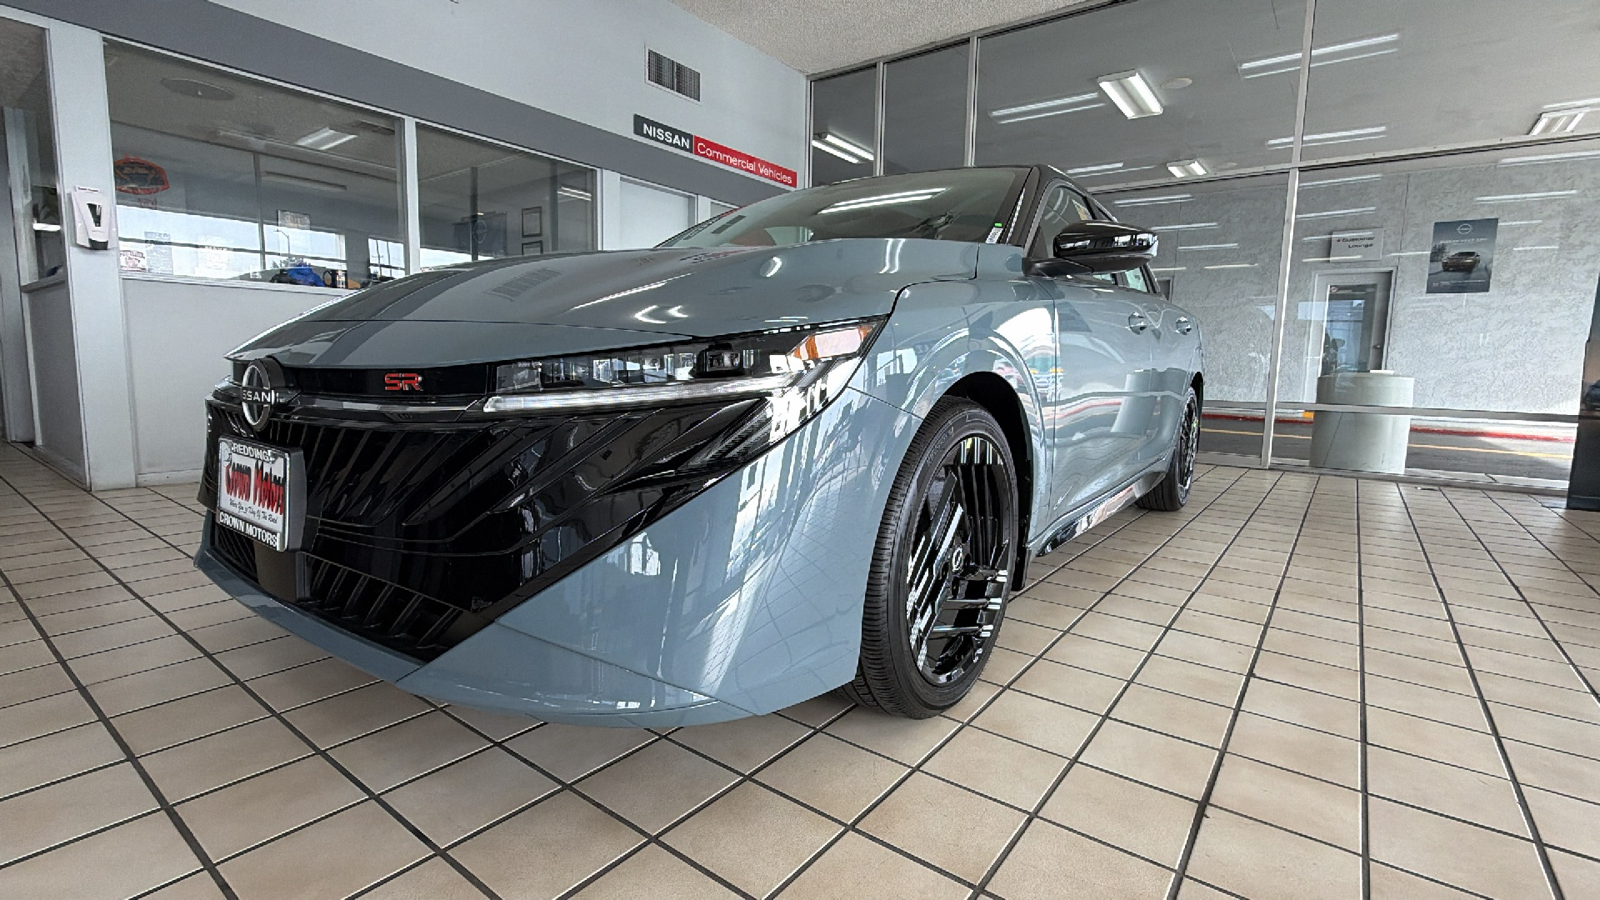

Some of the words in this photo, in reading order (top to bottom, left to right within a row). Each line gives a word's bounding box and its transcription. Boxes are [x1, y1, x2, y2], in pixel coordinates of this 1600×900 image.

[643, 122, 690, 149] NISSAN
[697, 142, 756, 171] Commercial
[758, 163, 793, 185] Vehicles
[384, 372, 423, 391] SR
[219, 511, 245, 533] CROWN
[245, 523, 278, 548] MOTORS
